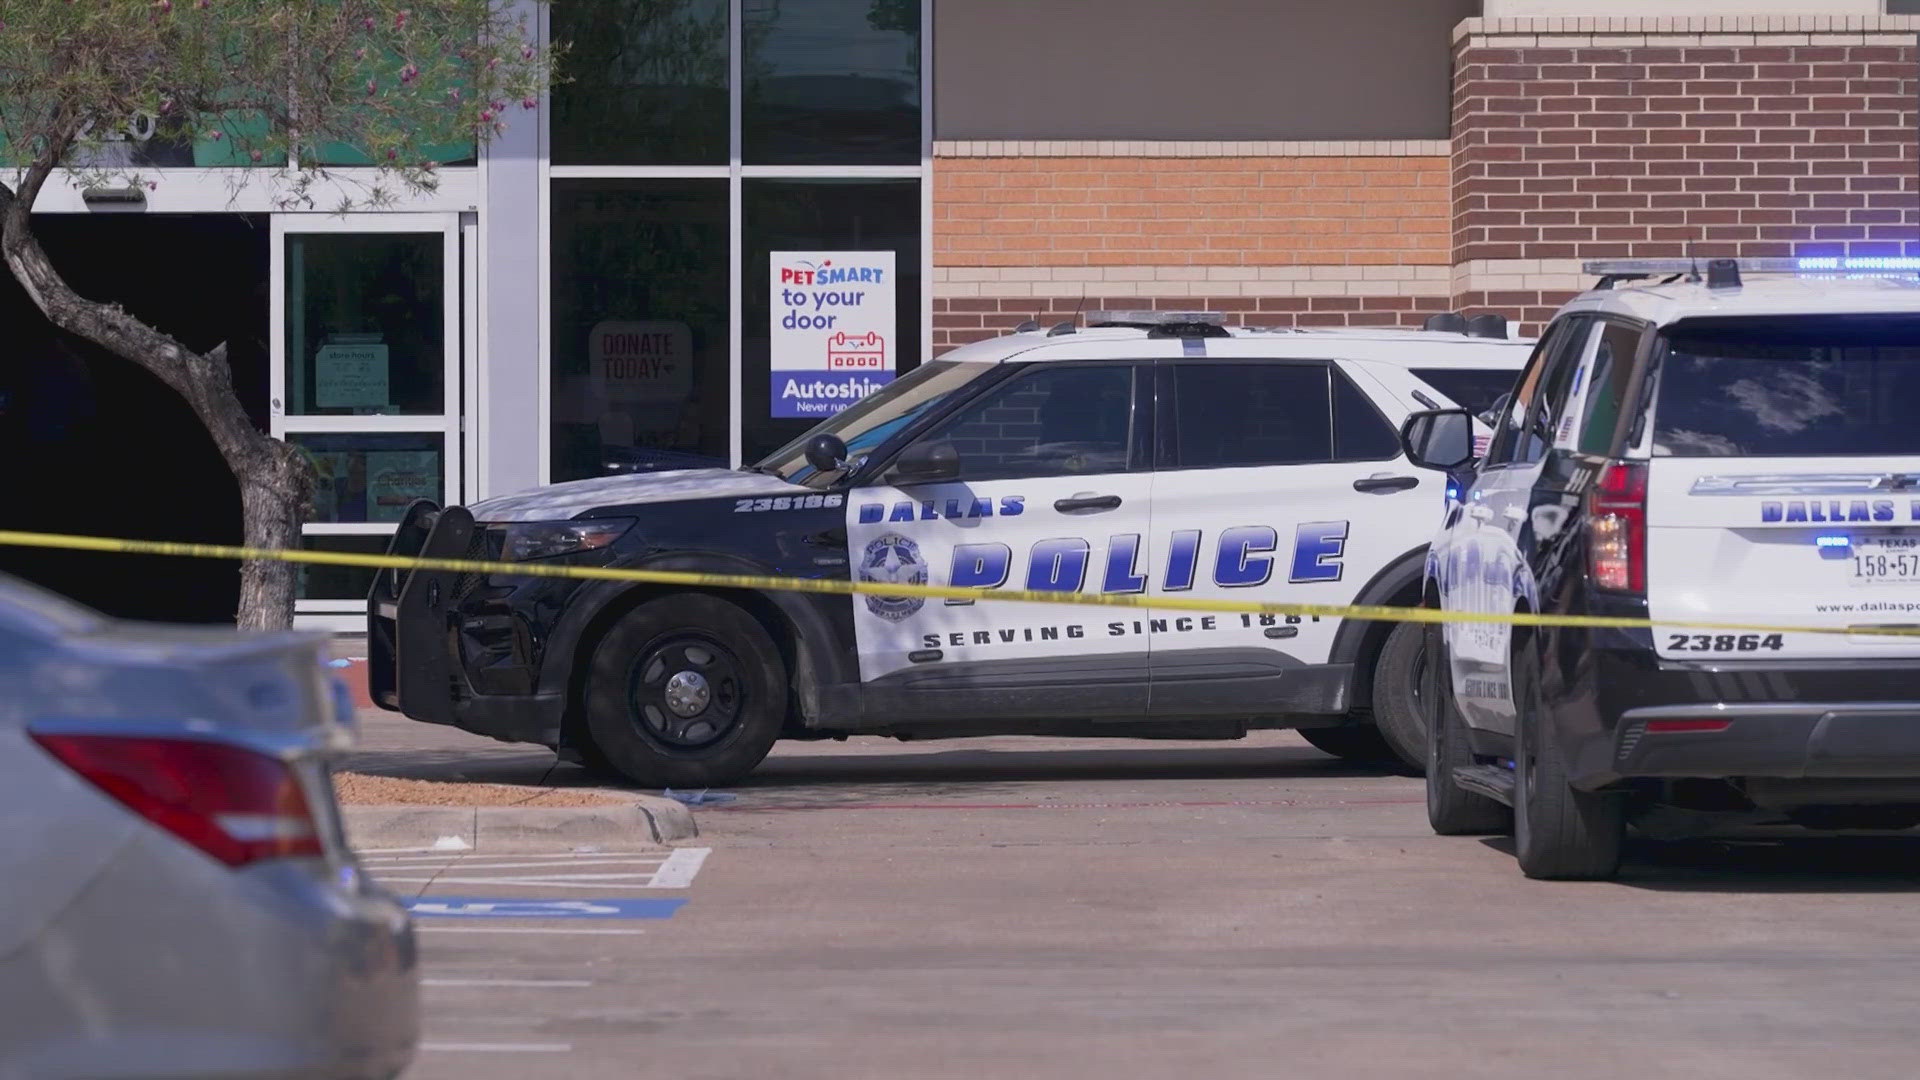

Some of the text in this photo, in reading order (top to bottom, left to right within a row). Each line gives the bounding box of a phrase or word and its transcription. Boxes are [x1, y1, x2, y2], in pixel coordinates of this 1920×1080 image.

[781, 267, 883, 285] PETSMART
[782, 288, 865, 312] to your
[782, 309, 837, 330] door
[603, 333, 674, 355] DONATE
[603, 357, 662, 379] TODAY
[796, 402, 828, 412] Never
[734, 494, 842, 513] 238186
[859, 495, 1026, 524] DALLAS
[1761, 500, 1895, 523] DALLAS
[866, 536, 919, 554] POLICE
[1879, 539, 1916, 548] TEXAS
[944, 520, 1350, 606] POLICE
[923, 624, 1085, 649] SERVING
[1107, 615, 1217, 637] SINCE
[1667, 634, 1784, 652] 23864
